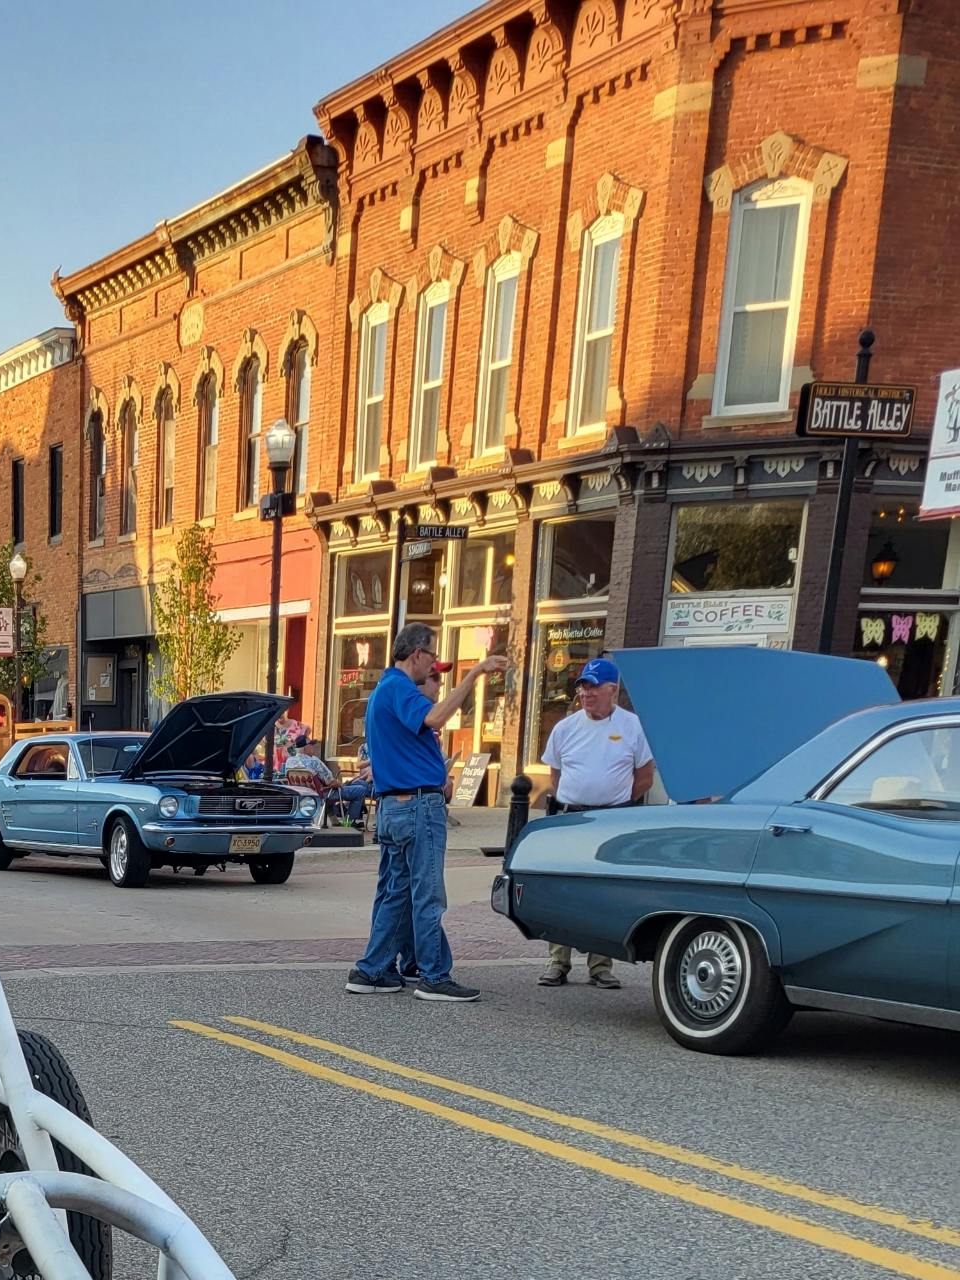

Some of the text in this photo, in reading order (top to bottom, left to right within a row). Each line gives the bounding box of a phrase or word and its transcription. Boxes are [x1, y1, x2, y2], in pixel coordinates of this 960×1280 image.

[811, 398, 911, 431] BATTLE ALLEY
[420, 526, 466, 538] BATTLE ALLEY
[692, 604, 765, 623] COFFEE
[563, 627, 583, 639] Roasted
[584, 626, 603, 638] Coffee
